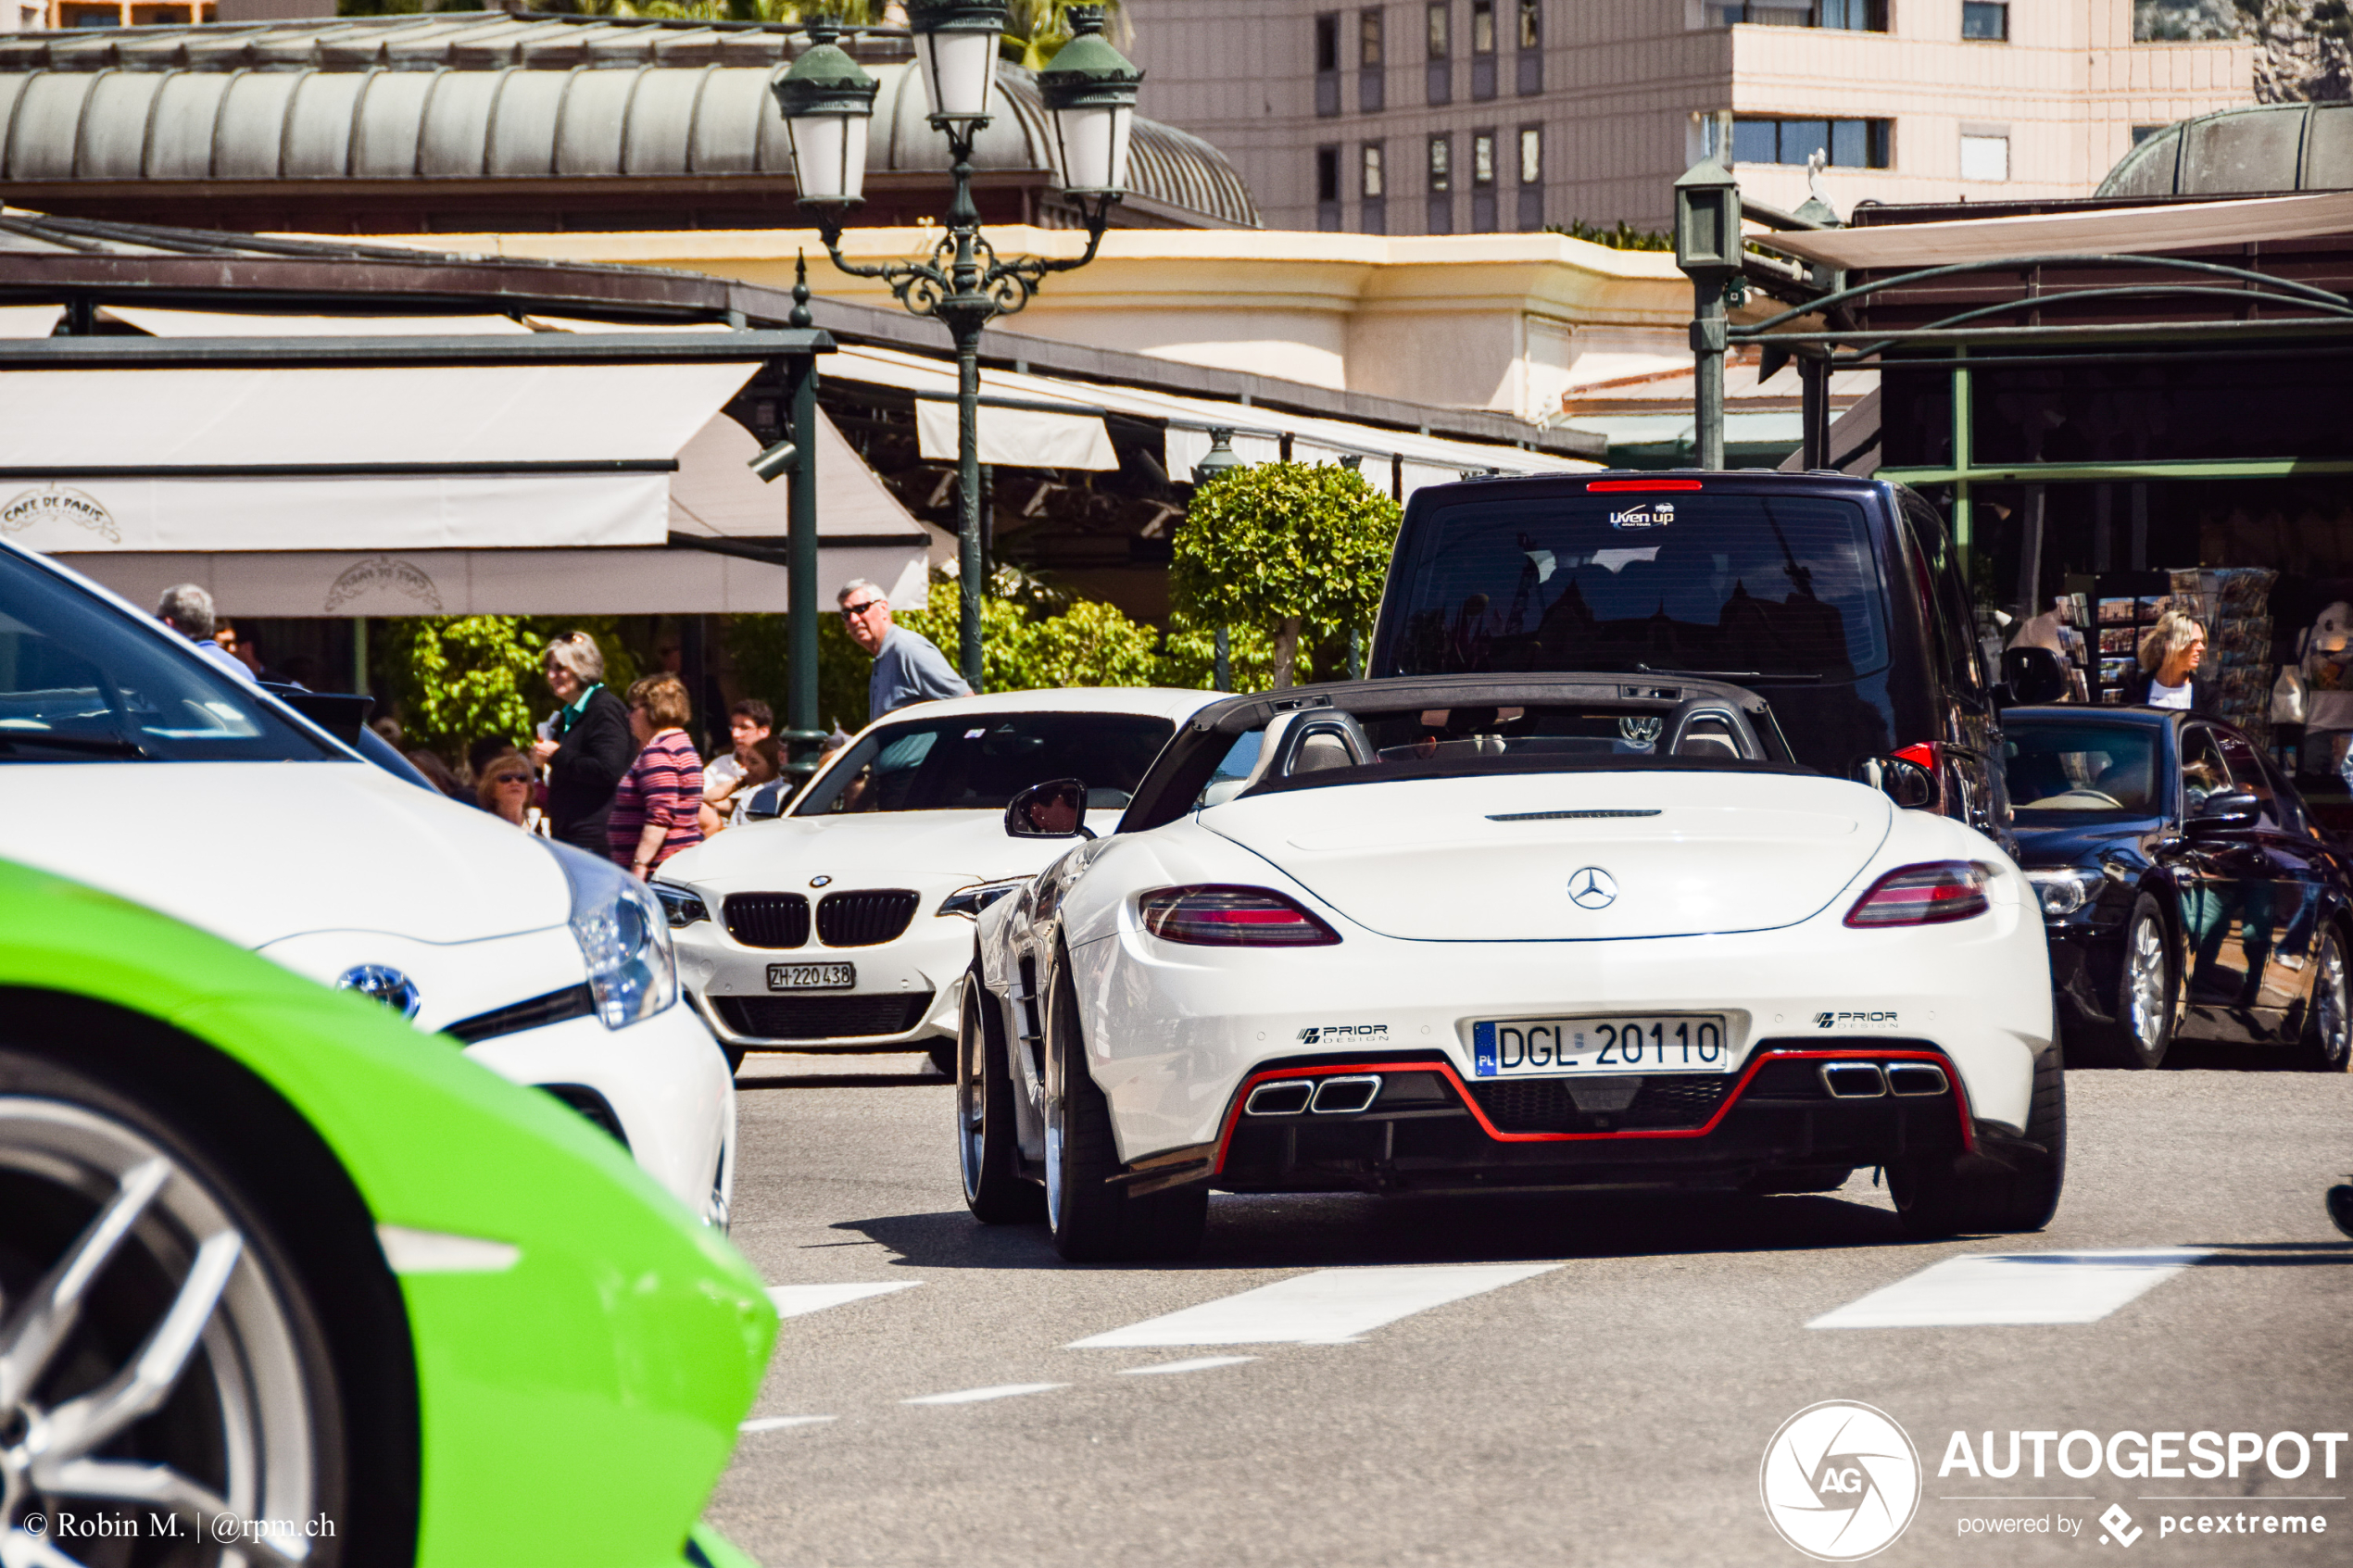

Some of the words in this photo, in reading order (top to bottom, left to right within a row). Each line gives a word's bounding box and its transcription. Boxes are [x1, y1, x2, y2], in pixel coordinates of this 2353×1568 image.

[43, 496, 59, 508] DE
[64, 497, 103, 521] PARIS
[1610, 508, 1650, 523] Liven
[1653, 513, 1675, 526] up
[823, 966, 850, 985] 438
[1838, 1011, 1898, 1022] PRIOR
[1323, 1024, 1388, 1036] PRIOR
[1323, 1035, 1390, 1044] DESIGN
[1500, 1025, 1579, 1069] DGL
[1594, 1022, 1719, 1065] 20110
[1478, 1055, 1494, 1067] PL
